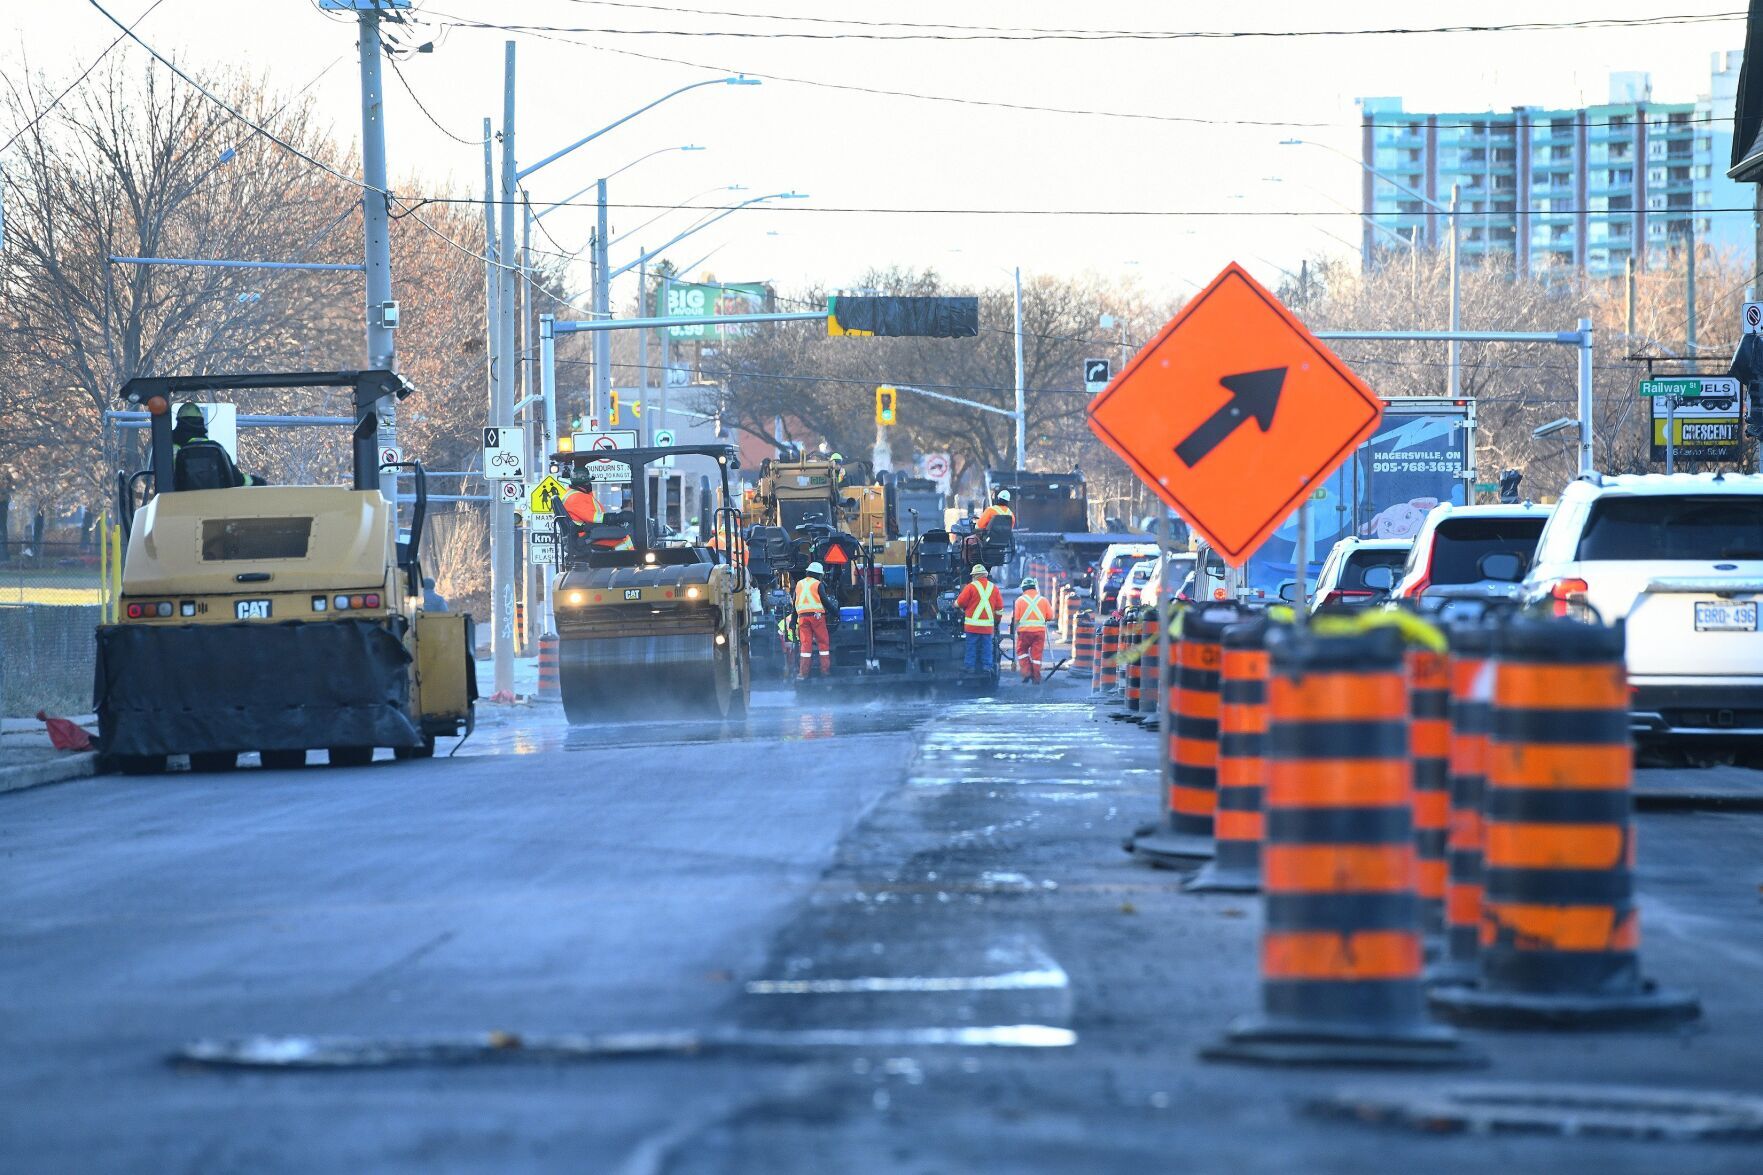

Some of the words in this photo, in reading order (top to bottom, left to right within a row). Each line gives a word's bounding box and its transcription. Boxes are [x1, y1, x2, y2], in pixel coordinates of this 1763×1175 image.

[668, 289, 705, 309] BIG
[1643, 382, 1687, 395] Railway
[1682, 424, 1732, 440] CRESCENT
[1374, 451, 1444, 460] HAGERSVILLE,
[1445, 451, 1461, 460] ON
[1373, 462, 1462, 472] 905-768-3633
[624, 590, 640, 600] CAT
[237, 601, 270, 620] CAT
[1733, 608, 1756, 624] 496
